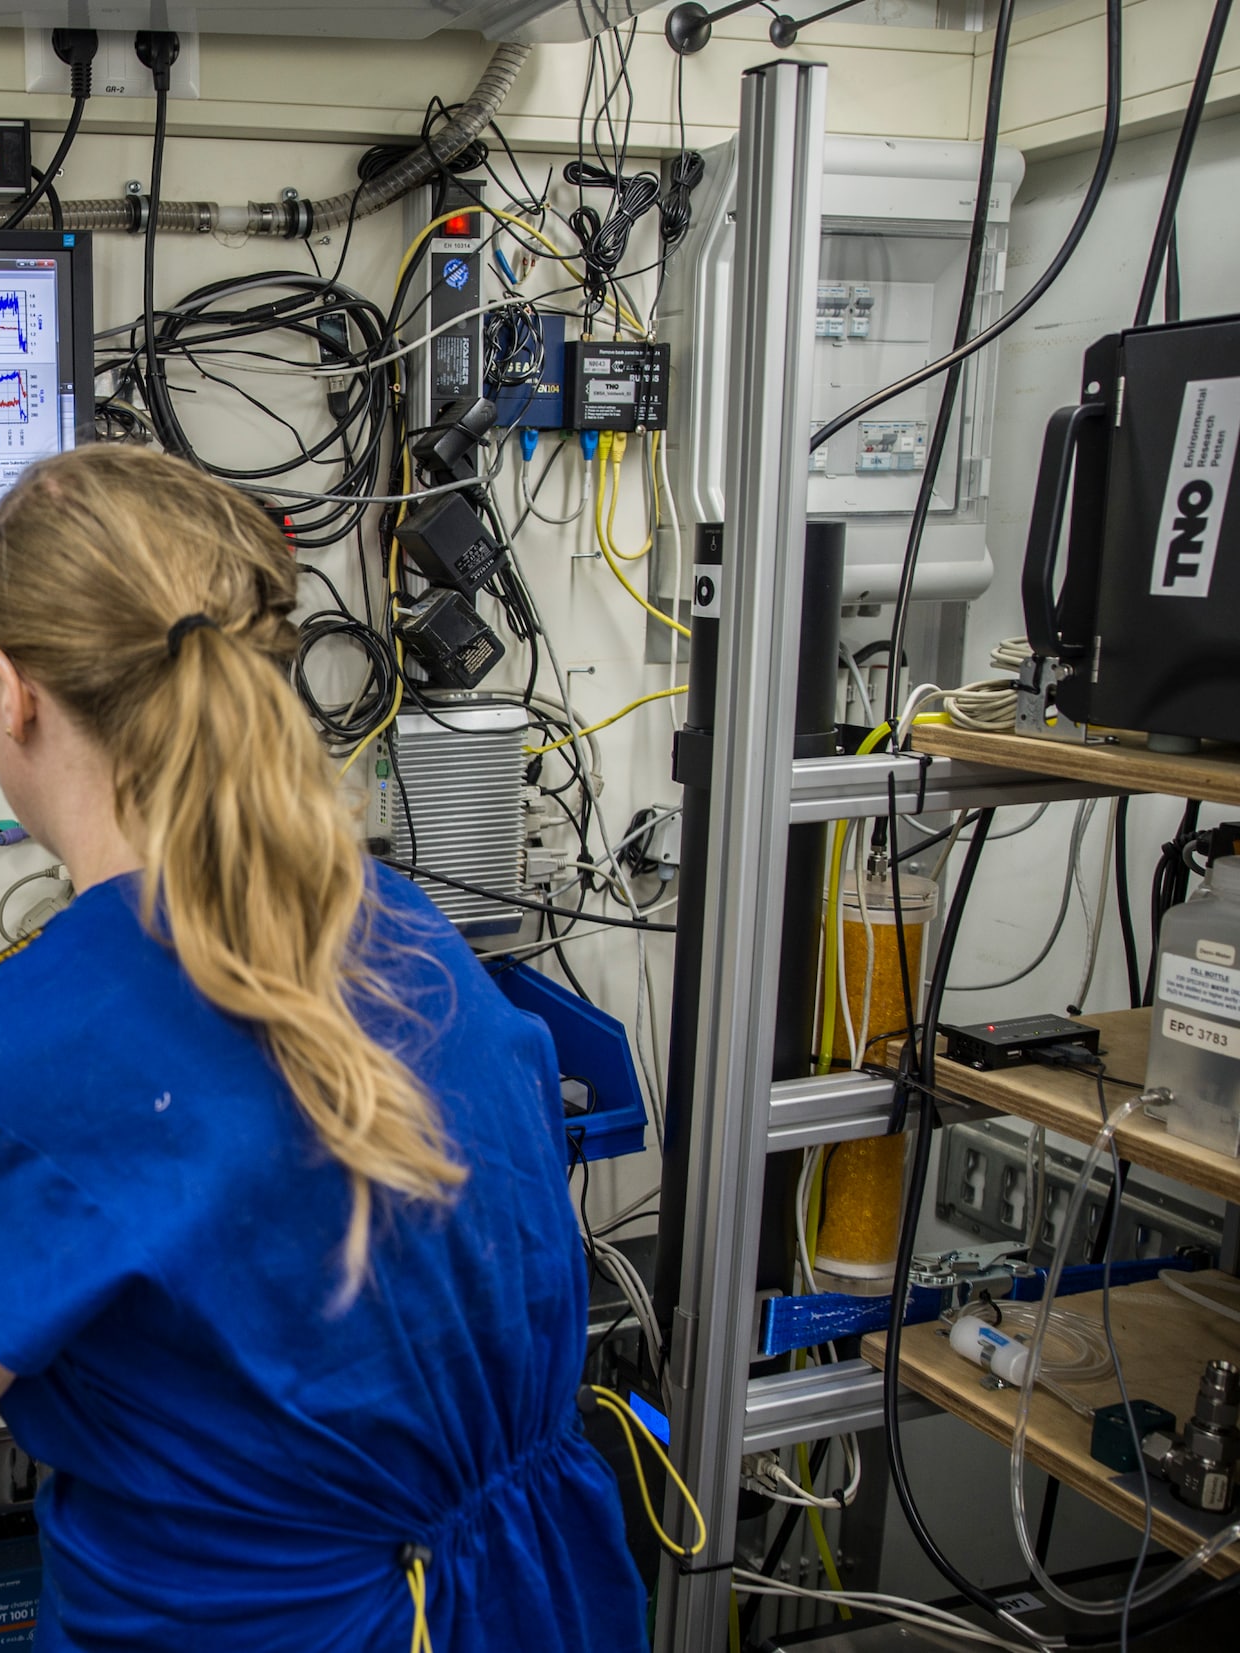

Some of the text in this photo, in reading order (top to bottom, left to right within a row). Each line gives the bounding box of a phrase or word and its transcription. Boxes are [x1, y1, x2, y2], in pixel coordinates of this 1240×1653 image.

[105, 86, 124, 94] GR-2
[1184, 388, 1208, 468] Environmental
[1198, 415, 1216, 468] Research
[1210, 430, 1226, 468] Petten
[1162, 479, 1214, 586] TNO
[1190, 967, 1230, 982] FILL BOTTLE
[1211, 984, 1229, 992] WATER
[1170, 1020, 1228, 1046] EPC 3783
[10, 1600, 33, 1609] charge
[10, 1610, 28, 1621] 100
